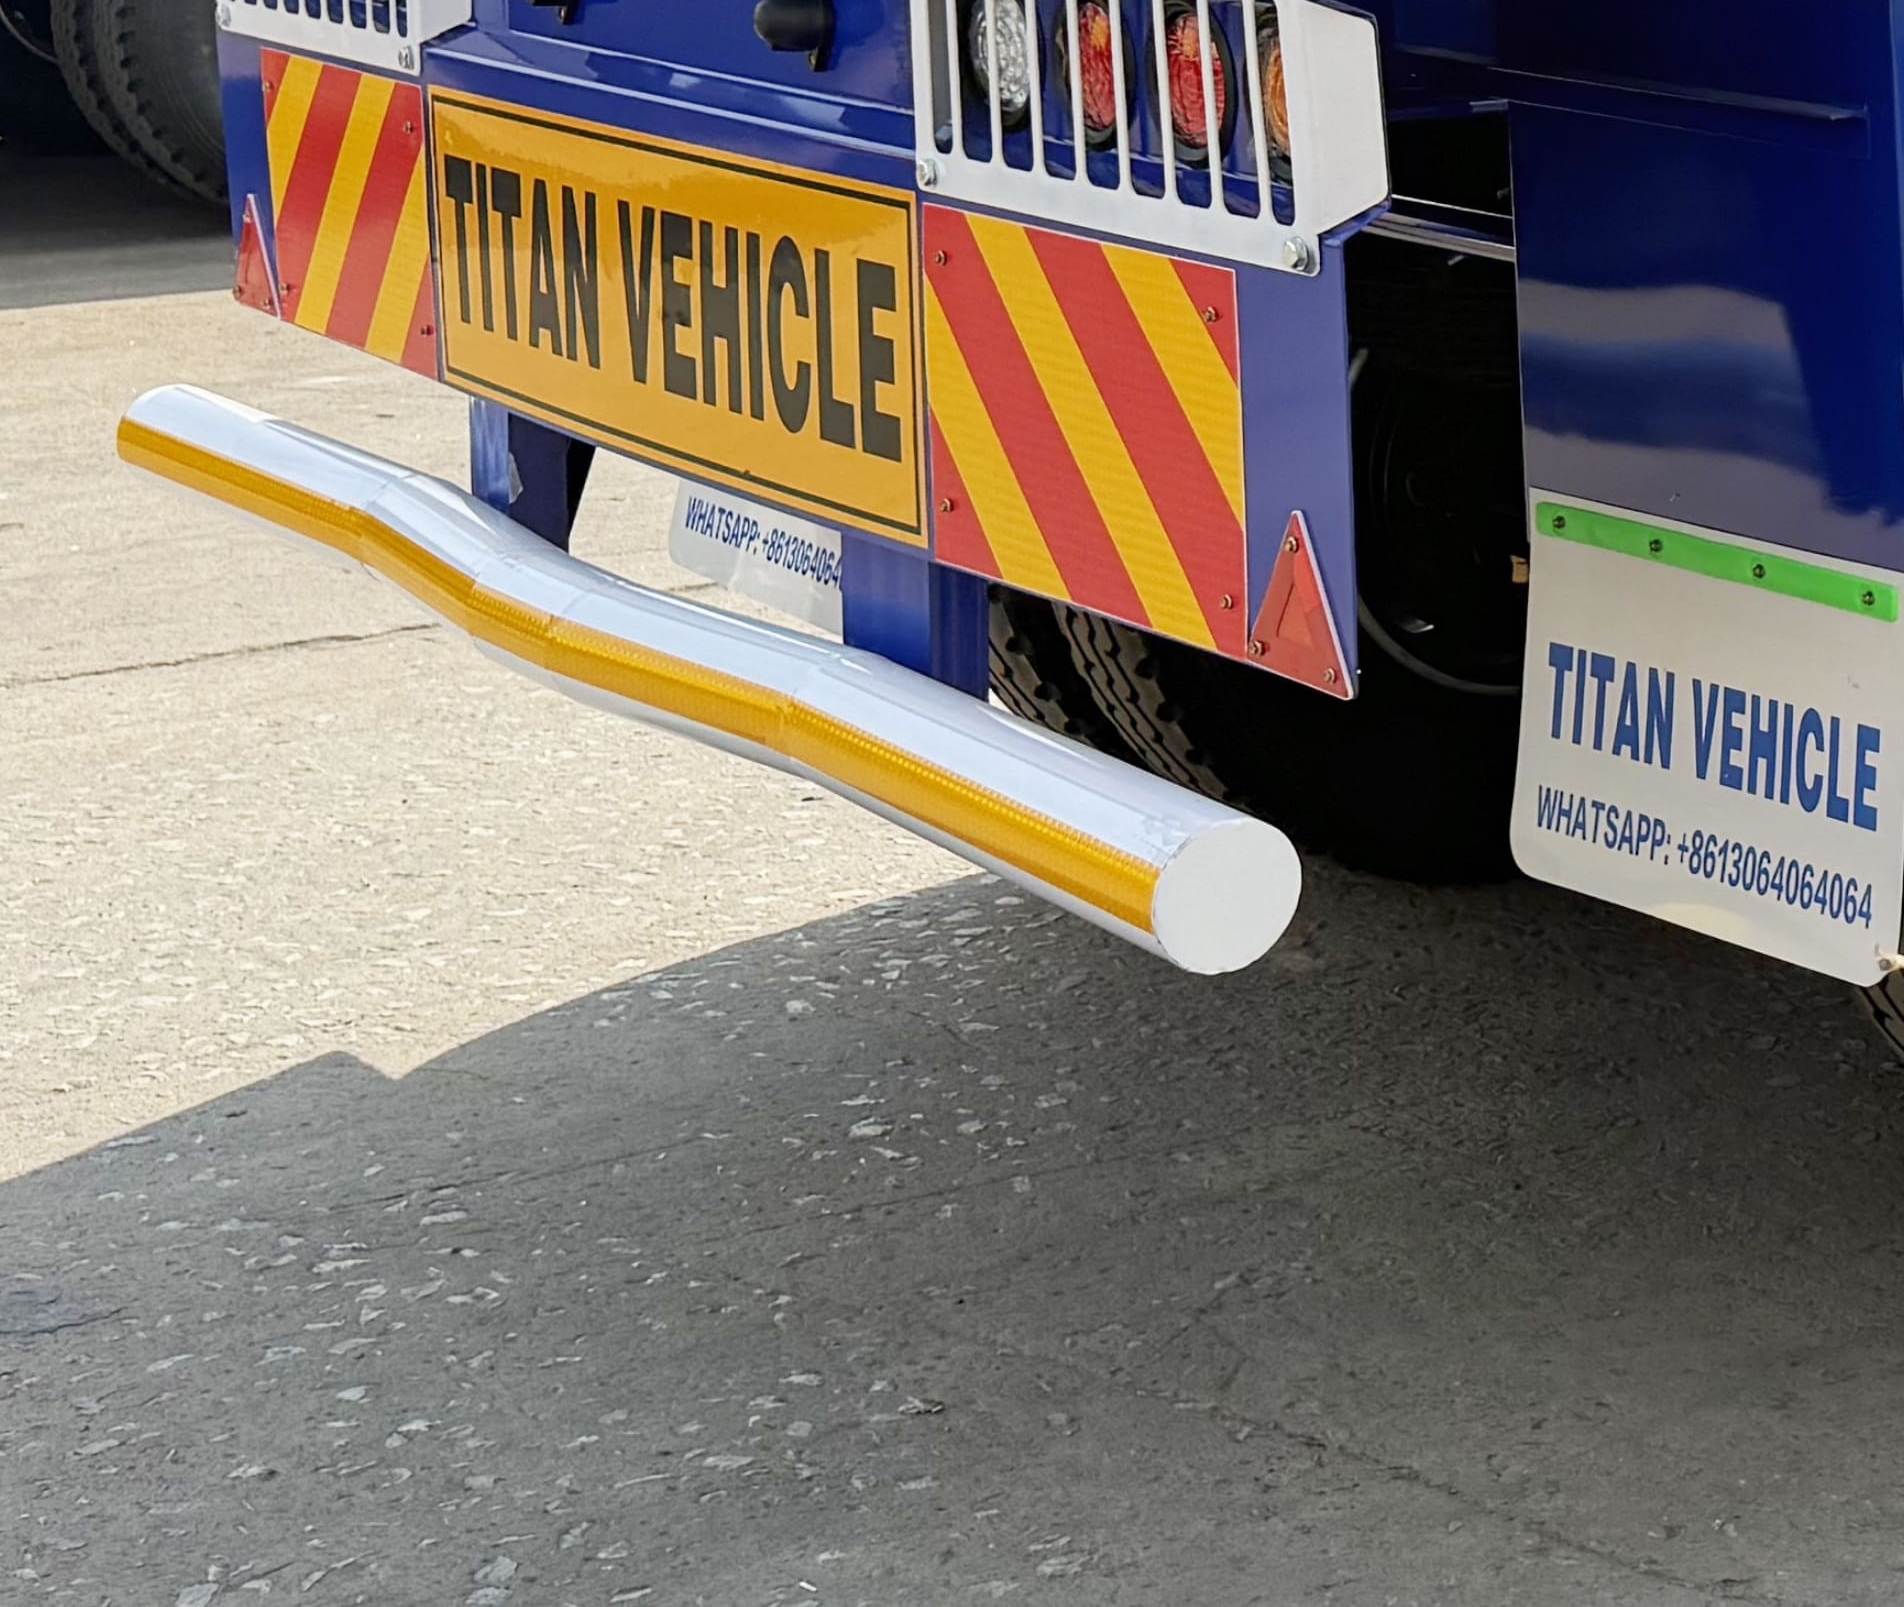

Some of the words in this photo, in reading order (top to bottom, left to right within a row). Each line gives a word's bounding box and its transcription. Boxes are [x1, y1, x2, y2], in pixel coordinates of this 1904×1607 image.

[443, 153, 601, 371] TITAN
[616, 199, 903, 464] VEHICLE
[684, 495, 761, 556] WHATSAPP:
[1548, 641, 1676, 770] TITAN
[1691, 677, 1882, 833] VEHICLE
[1536, 784, 1672, 867] WHATSAPP:
[1676, 829, 1874, 930] +8613064064064
